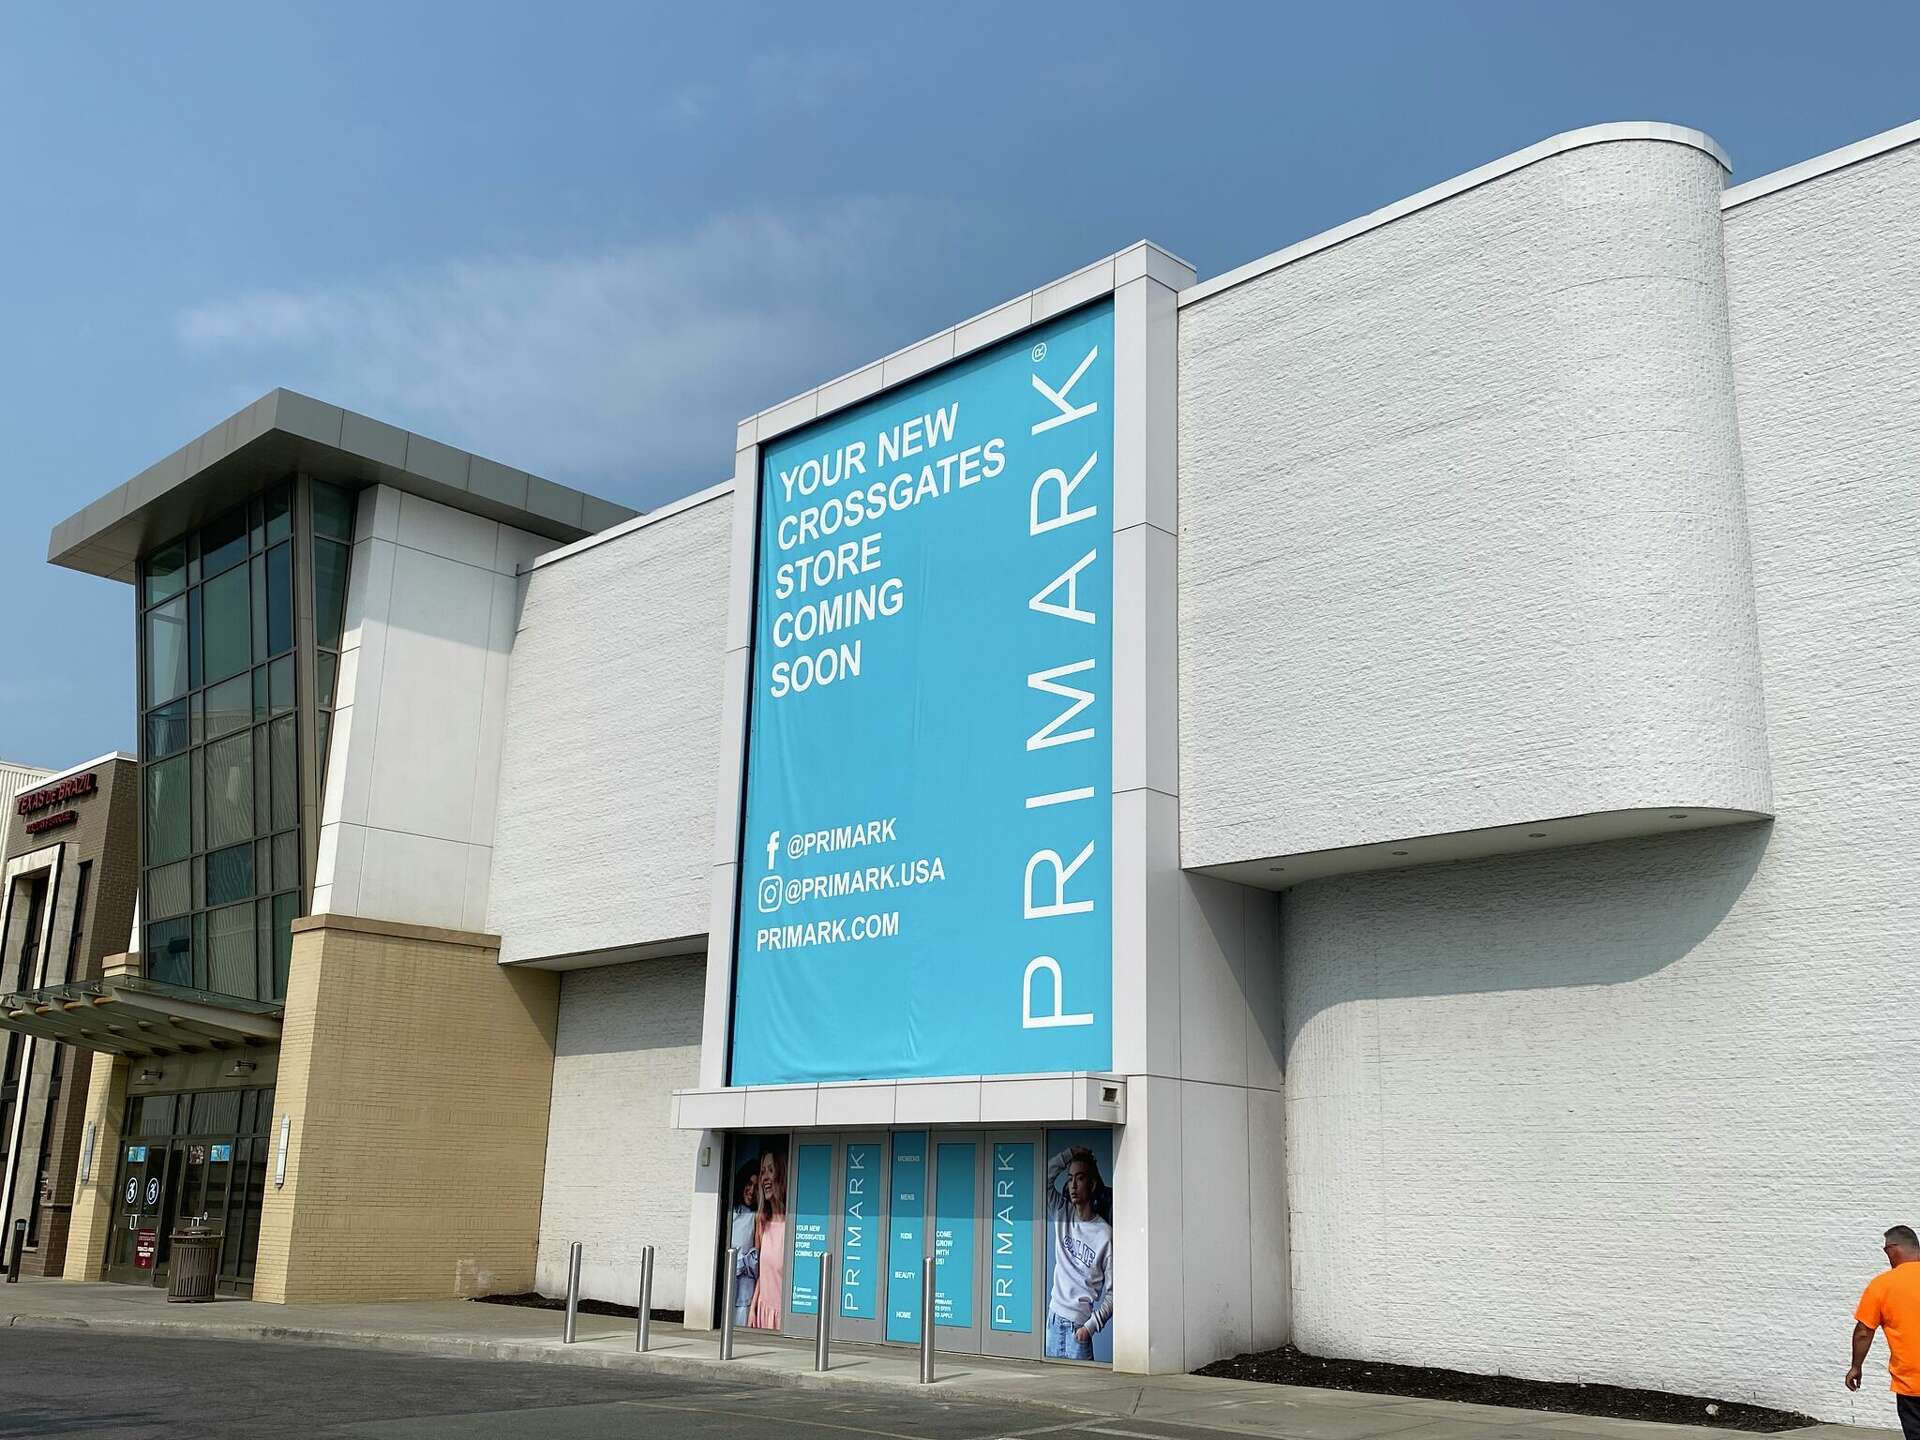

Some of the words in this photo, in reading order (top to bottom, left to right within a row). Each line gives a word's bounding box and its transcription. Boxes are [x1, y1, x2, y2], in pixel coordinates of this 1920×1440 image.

[779, 441, 866, 502] YOUR
[878, 402, 959, 467] NEW
[777, 437, 1006, 551] CROSSGATES
[775, 532, 882, 600] STORE
[773, 578, 904, 649] COMING
[770, 640, 861, 698] SOON
[18, 791, 45, 814] TEXAS
[58, 774, 92, 800] BRAZIL
[787, 817, 897, 859] @PRIMARK
[784, 857, 945, 905] @PRIMARK.USA
[756, 912, 899, 952] PRIMARK.COM
[795, 1233, 826, 1241] CROSSGATES
[795, 1241, 811, 1249] STORE
[796, 1224, 809, 1232] YOUR
[809, 1225, 821, 1233] NEW
[845, 1153, 865, 1311] PRIMARK
[900, 1232, 913, 1240] KIDS
[936, 1230, 952, 1238] COME
[936, 1239, 953, 1247] GROW
[996, 1153, 1014, 1324] PRIMARK
[794, 1249, 813, 1258] COMING
[894, 1271, 916, 1280] BEAUTY
[895, 1311, 912, 1319] HOME
